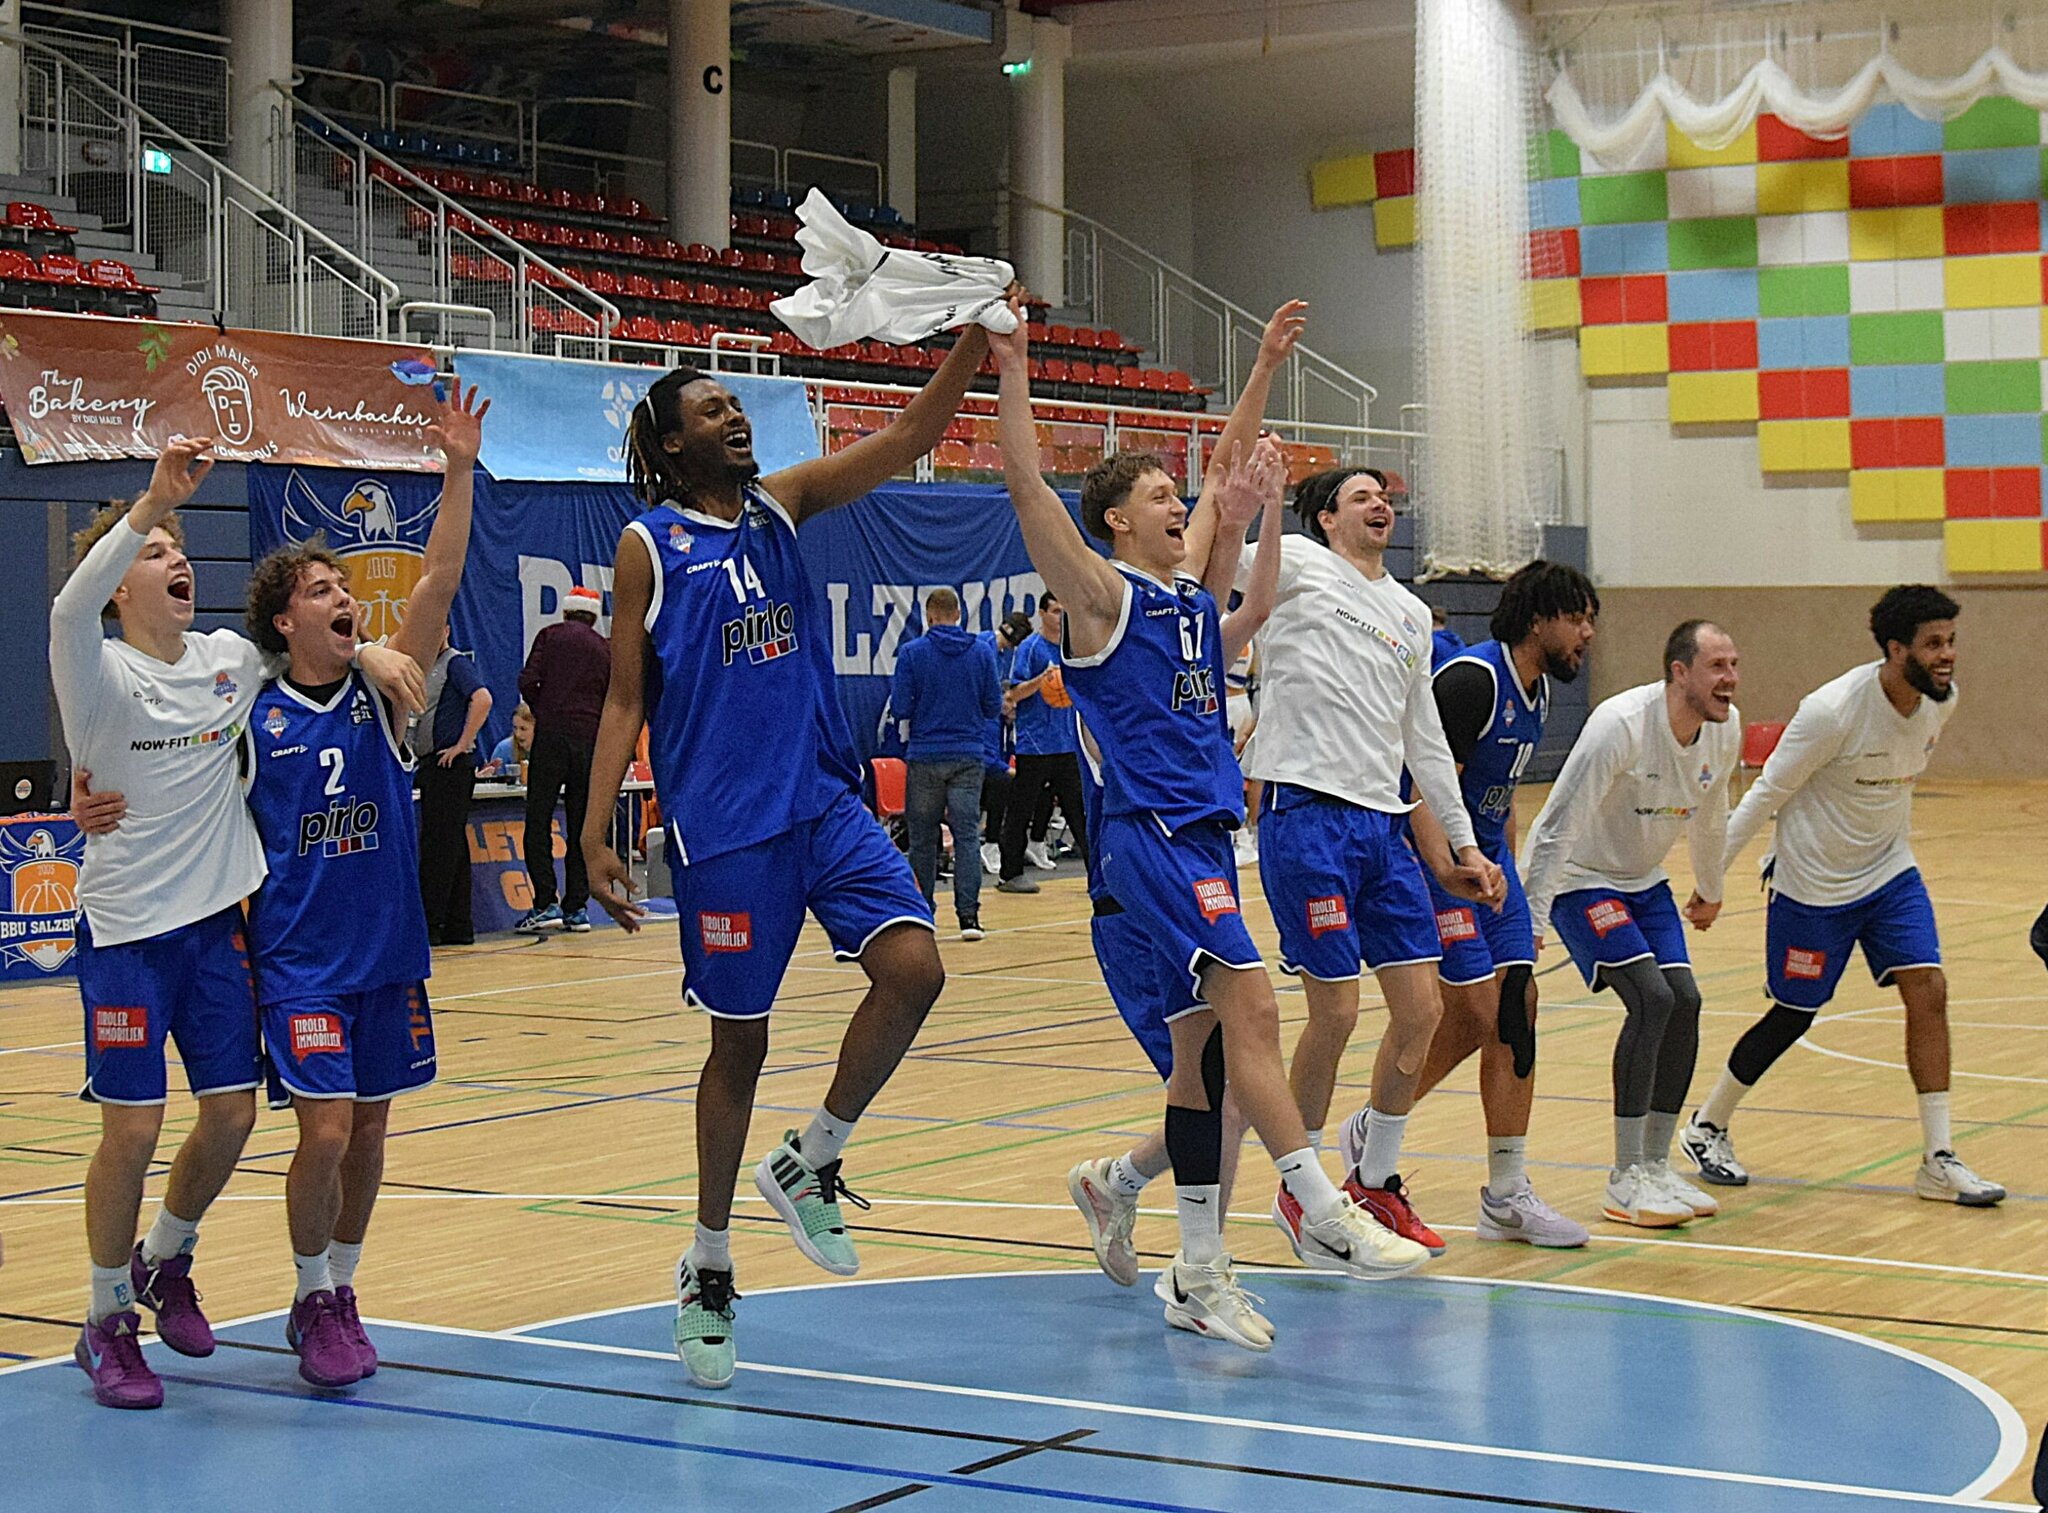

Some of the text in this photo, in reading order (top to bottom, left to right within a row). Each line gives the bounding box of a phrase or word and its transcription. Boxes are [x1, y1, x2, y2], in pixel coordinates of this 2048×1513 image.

[703, 65, 722, 94] C
[186, 345, 259, 379] DIDI MAIER
[40, 369, 73, 387] The
[29, 377, 156, 431] Bakery
[279, 388, 432, 426] Wernbacher
[71, 414, 123, 426] BY DIDI MAIER
[367, 556, 397, 580] 2005
[686, 554, 766, 604] CRAFT 14
[1145, 607, 1172, 617] CRAFT
[1335, 607, 1378, 634] NOW-FIT
[722, 599, 795, 667] pirlo
[1179, 611, 1205, 661] 61
[130, 736, 190, 751] NOW-FIT
[271, 747, 300, 758] CRAFT
[1509, 742, 1534, 779] 10
[318, 747, 346, 796] 2
[298, 795, 379, 856] pirlo
[1197, 881, 1227, 898] TIROLER
[0, 921, 26, 939] BBU
[701, 914, 731, 931] TIROLER
[703, 930, 747, 947] IMMOBILIEN
[97, 1011, 128, 1026] TIROLER
[294, 1018, 328, 1033] TIROLER
[97, 1027, 144, 1042] IMMOBILIEN
[296, 1033, 341, 1049] IMMOBILIEN
[411, 1056, 436, 1069] CRAFT
